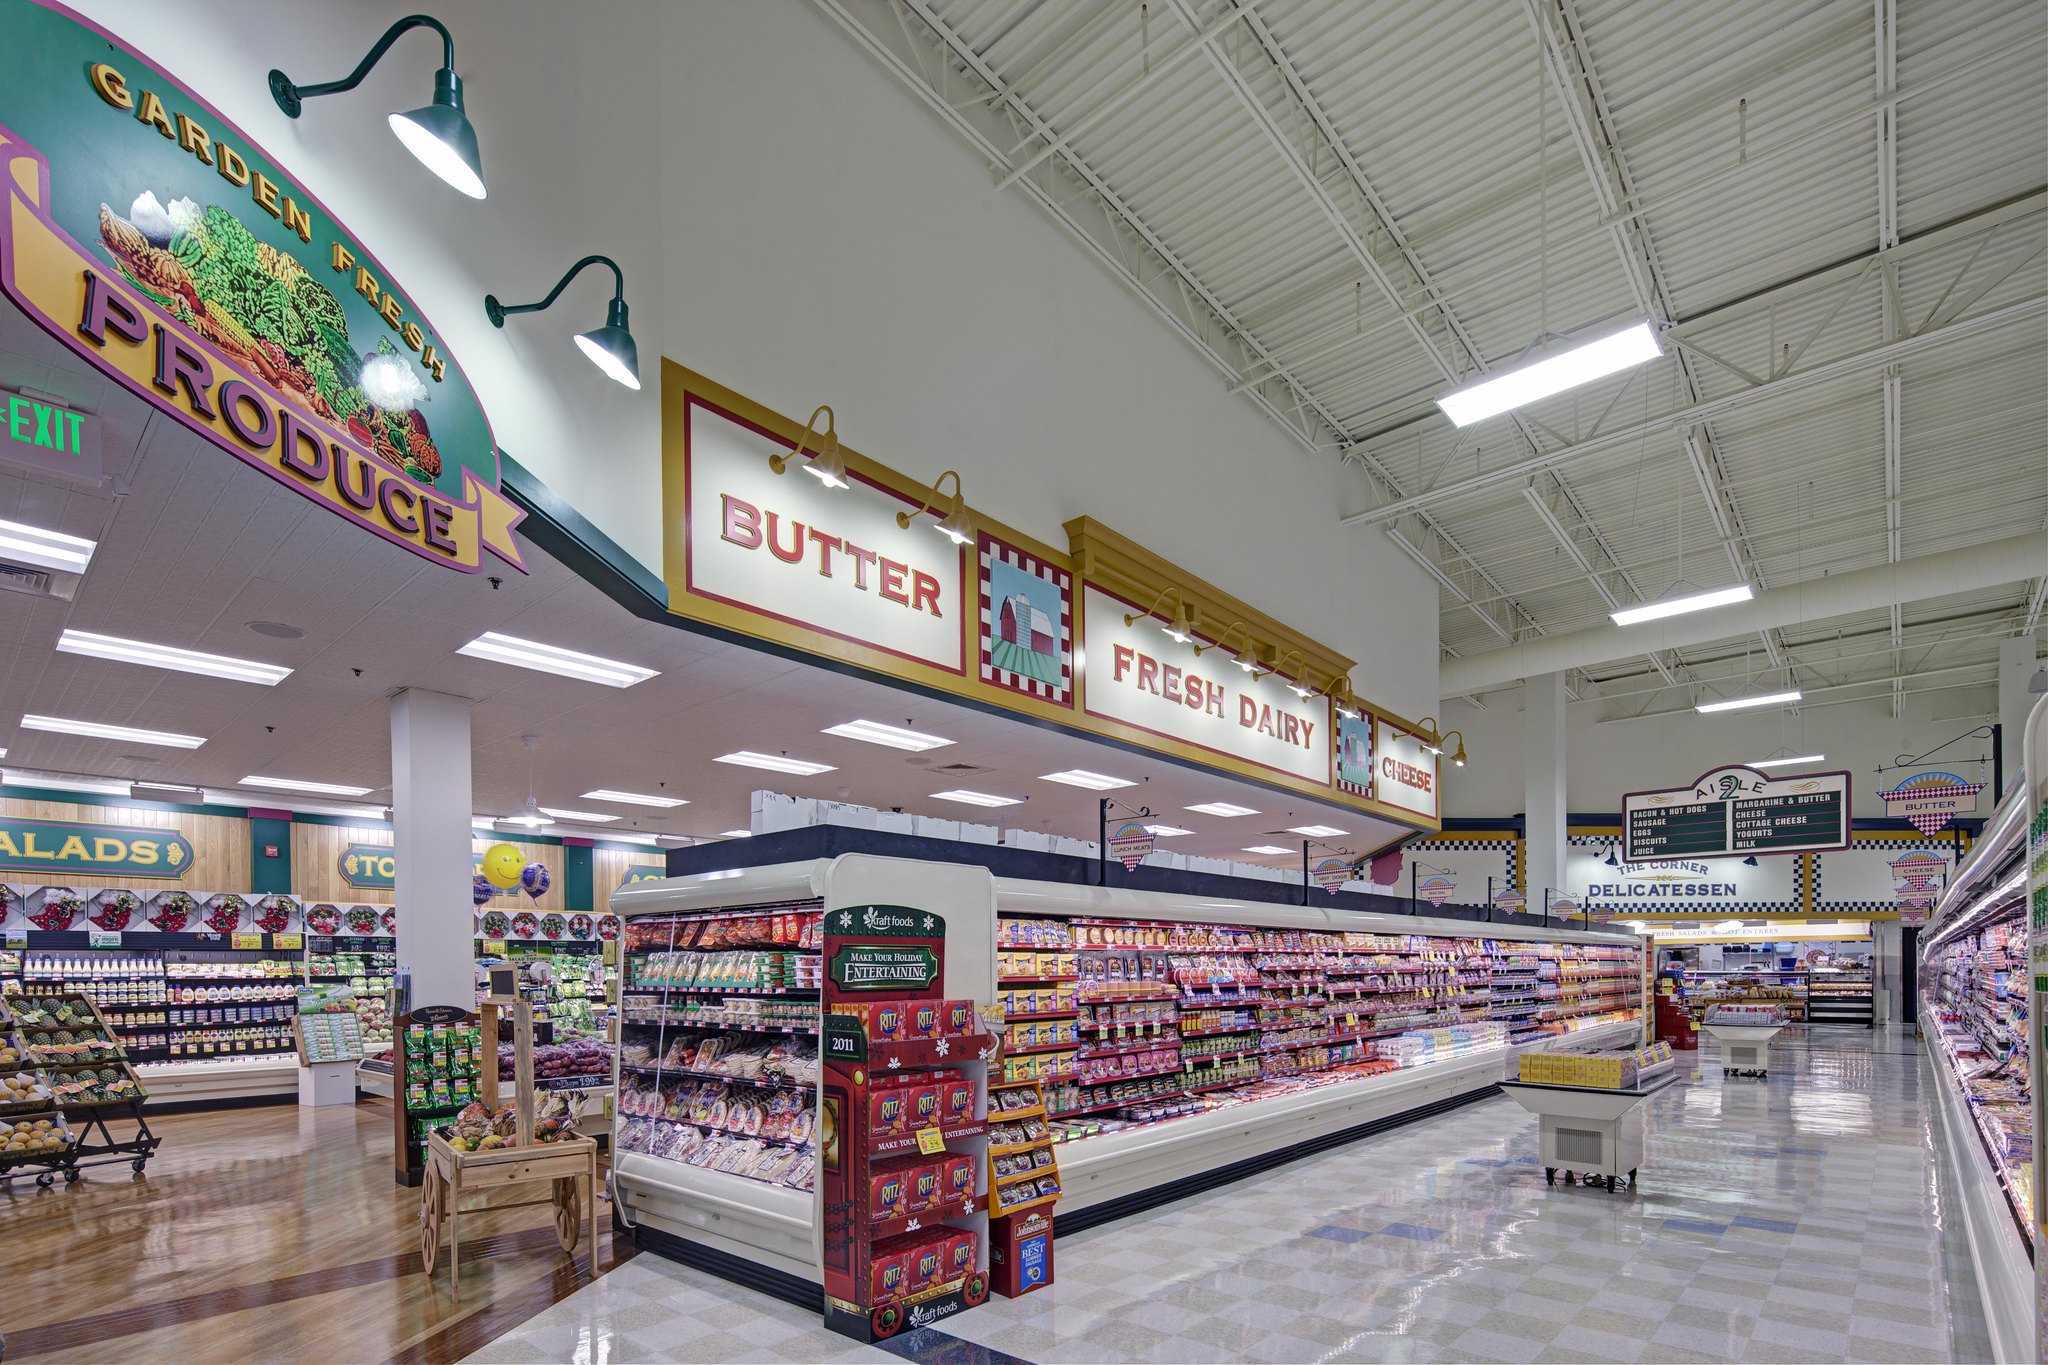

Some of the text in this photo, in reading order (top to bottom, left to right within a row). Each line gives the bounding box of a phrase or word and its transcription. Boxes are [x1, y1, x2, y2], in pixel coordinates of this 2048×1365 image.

[91, 62, 446, 383] GARDEN FRESH
[78, 269, 458, 556] PRODUCE
[9, 396, 84, 456] EXIT
[719, 493, 943, 618] BUTTER
[1113, 643, 1315, 750] FRESH DAIRY
[1381, 755, 1432, 794] CHEESE
[1696, 779, 1767, 800] AISLE
[1718, 775, 1740, 800] 2
[1736, 793, 1831, 809] MARGARINE & BUTTER
[1905, 801, 1956, 810] BUTTER
[1633, 810, 1657, 818] BACON
[1669, 807, 1684, 816] HOT
[1686, 805, 1707, 814] DOGS
[1736, 810, 1767, 818] CHEESE
[1633, 818, 1667, 828] SAUSAGE
[1736, 816, 1807, 829] COTTAGE CHEESE
[1633, 828, 1652, 837] EGGS
[1633, 837, 1668, 846] BISCUITS
[1736, 829, 1773, 838] YOGURTS
[1633, 847, 1655, 856] JUICE
[1736, 840, 1756, 848] MILK
[1617, 861, 1709, 876] THE CORNER
[1588, 883, 1737, 897] DELICATESSEN
[892, 915, 914, 927] foods
[850, 953, 924, 962] MAKE YOUR HOLIDAY
[844, 962, 926, 983] ENTERTAINING
[880, 1012, 898, 1031] RITZ
[918, 1010, 934, 1028] RITZ
[951, 1010, 968, 1026] RITZ
[832, 1038, 854, 1052] 2011
[882, 1100, 899, 1120] RITZ
[918, 1096, 935, 1114] RITZ
[952, 1092, 968, 1110] RITZ
[878, 1142, 898, 1151] MAKE
[900, 1138, 917, 1148] YOUR
[944, 1126, 984, 1139] ENTERTAINING
[918, 1176, 934, 1194] RITZ
[953, 1168, 968, 1186] RITZ
[882, 1184, 899, 1204] RITZ
[1016, 1220, 1049, 1238] Johnsonville
[954, 1245, 970, 1266] RITZ
[1022, 1244, 1046, 1259] BEST
[920, 1255, 936, 1276] RITZ
[883, 1266, 902, 1288] RITZ
[936, 1300, 958, 1316] foods
